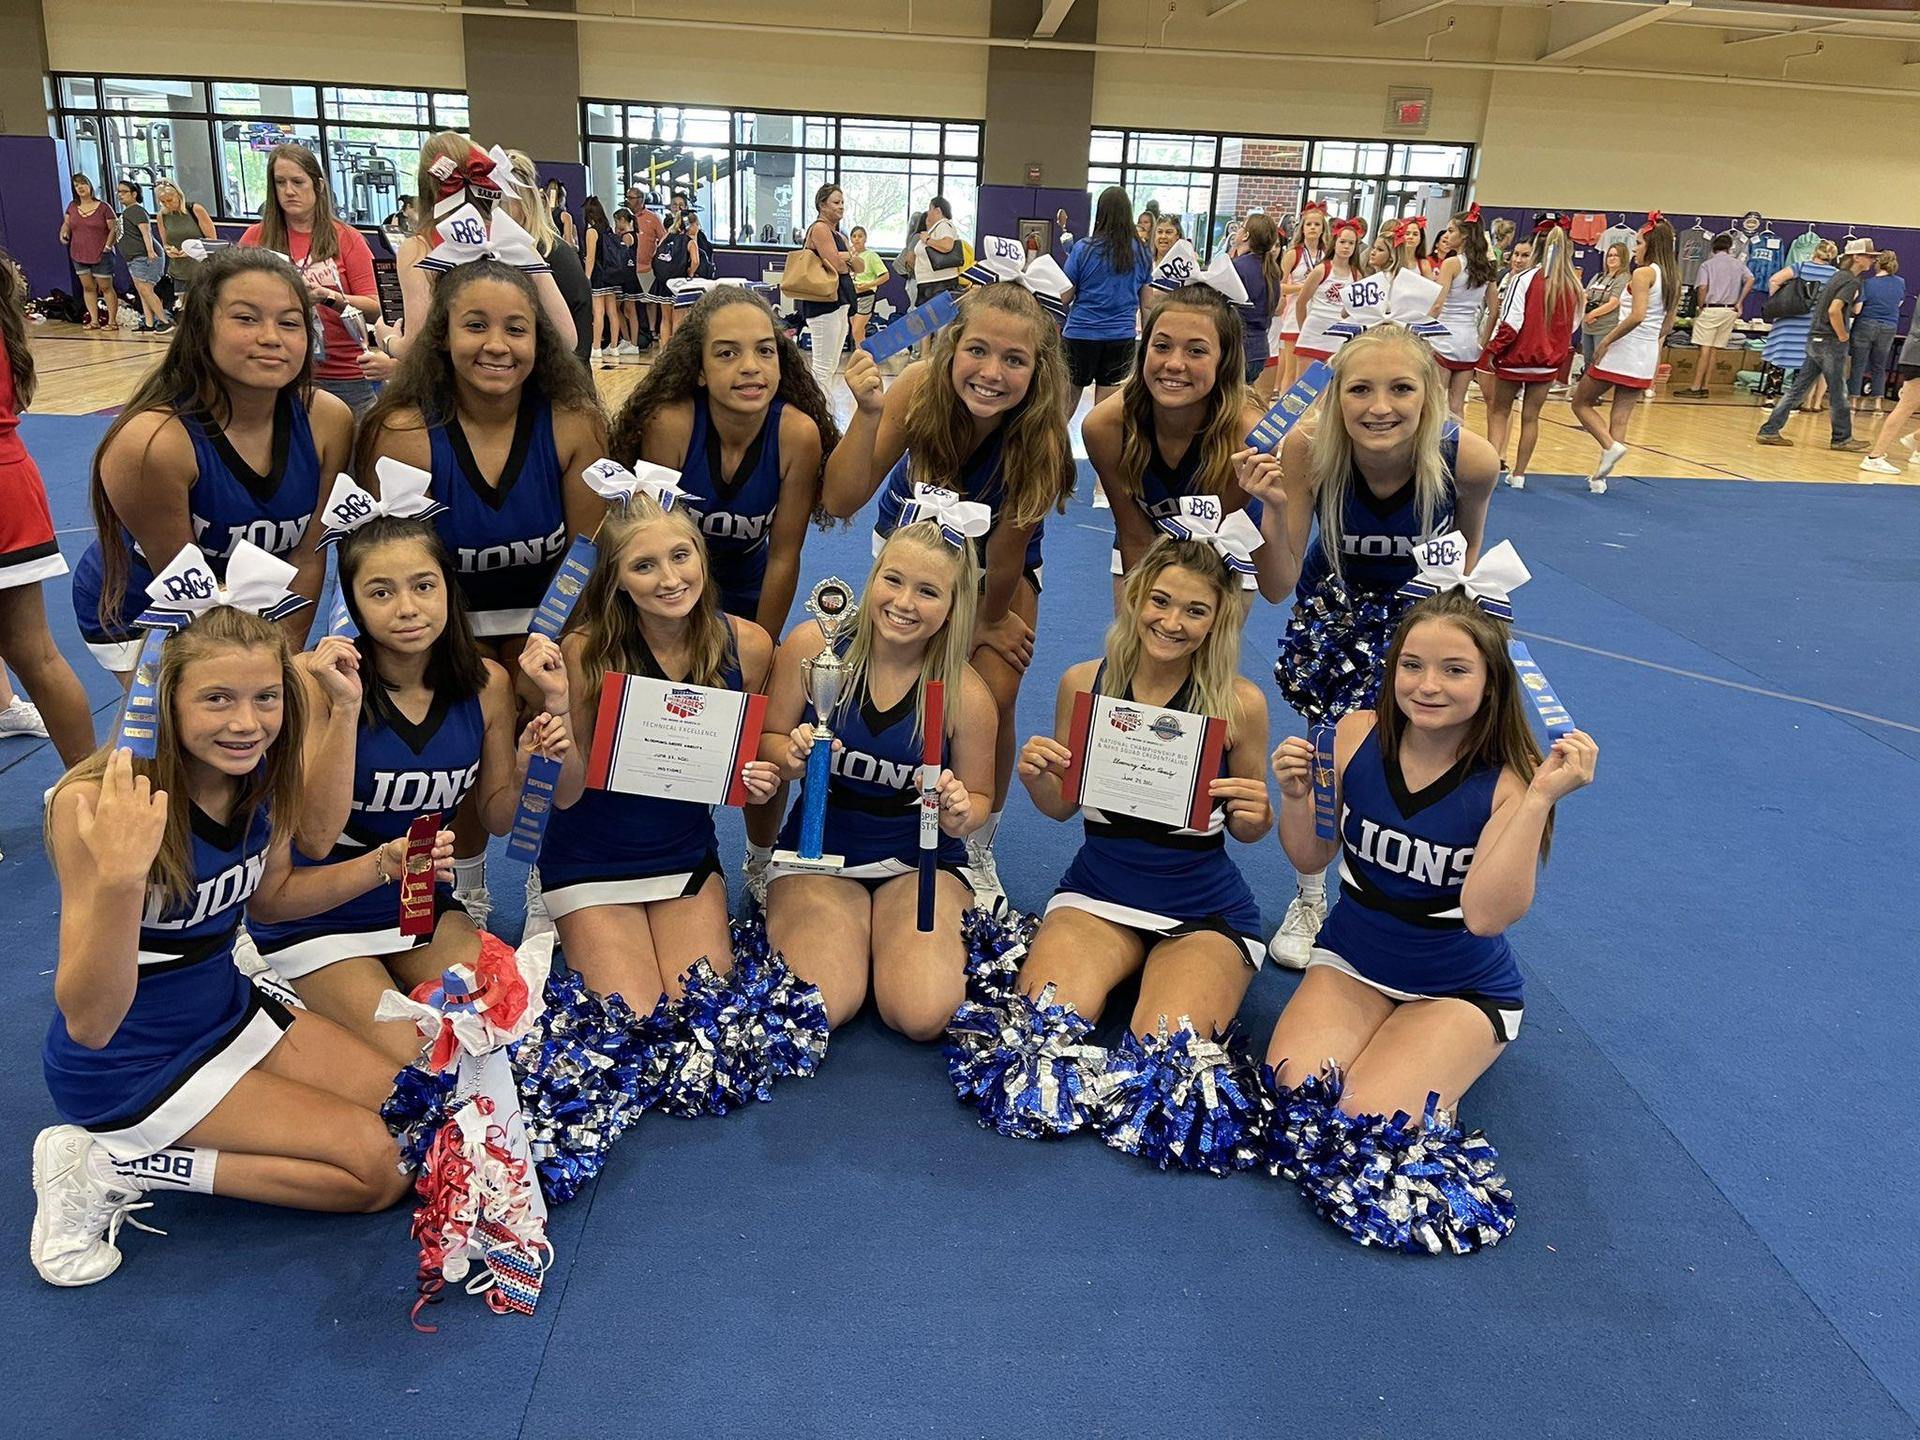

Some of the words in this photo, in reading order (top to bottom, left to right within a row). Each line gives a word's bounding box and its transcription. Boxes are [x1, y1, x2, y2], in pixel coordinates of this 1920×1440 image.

[995, 236, 1021, 259] BG
[1351, 282, 1379, 307] BG
[1190, 497, 1215, 520] BG
[1426, 540, 1455, 566] BG
[642, 720, 676, 733] TECHNICAL
[679, 724, 718, 738] EXCELLENCE
[1099, 737, 1128, 749] NATIONAL
[1130, 743, 1176, 758] CHAMPIONSHIP
[1177, 753, 1188, 761] BID
[1120, 747, 1141, 757] SQUAD
[1142, 752, 1189, 766] CREDENTIALING
